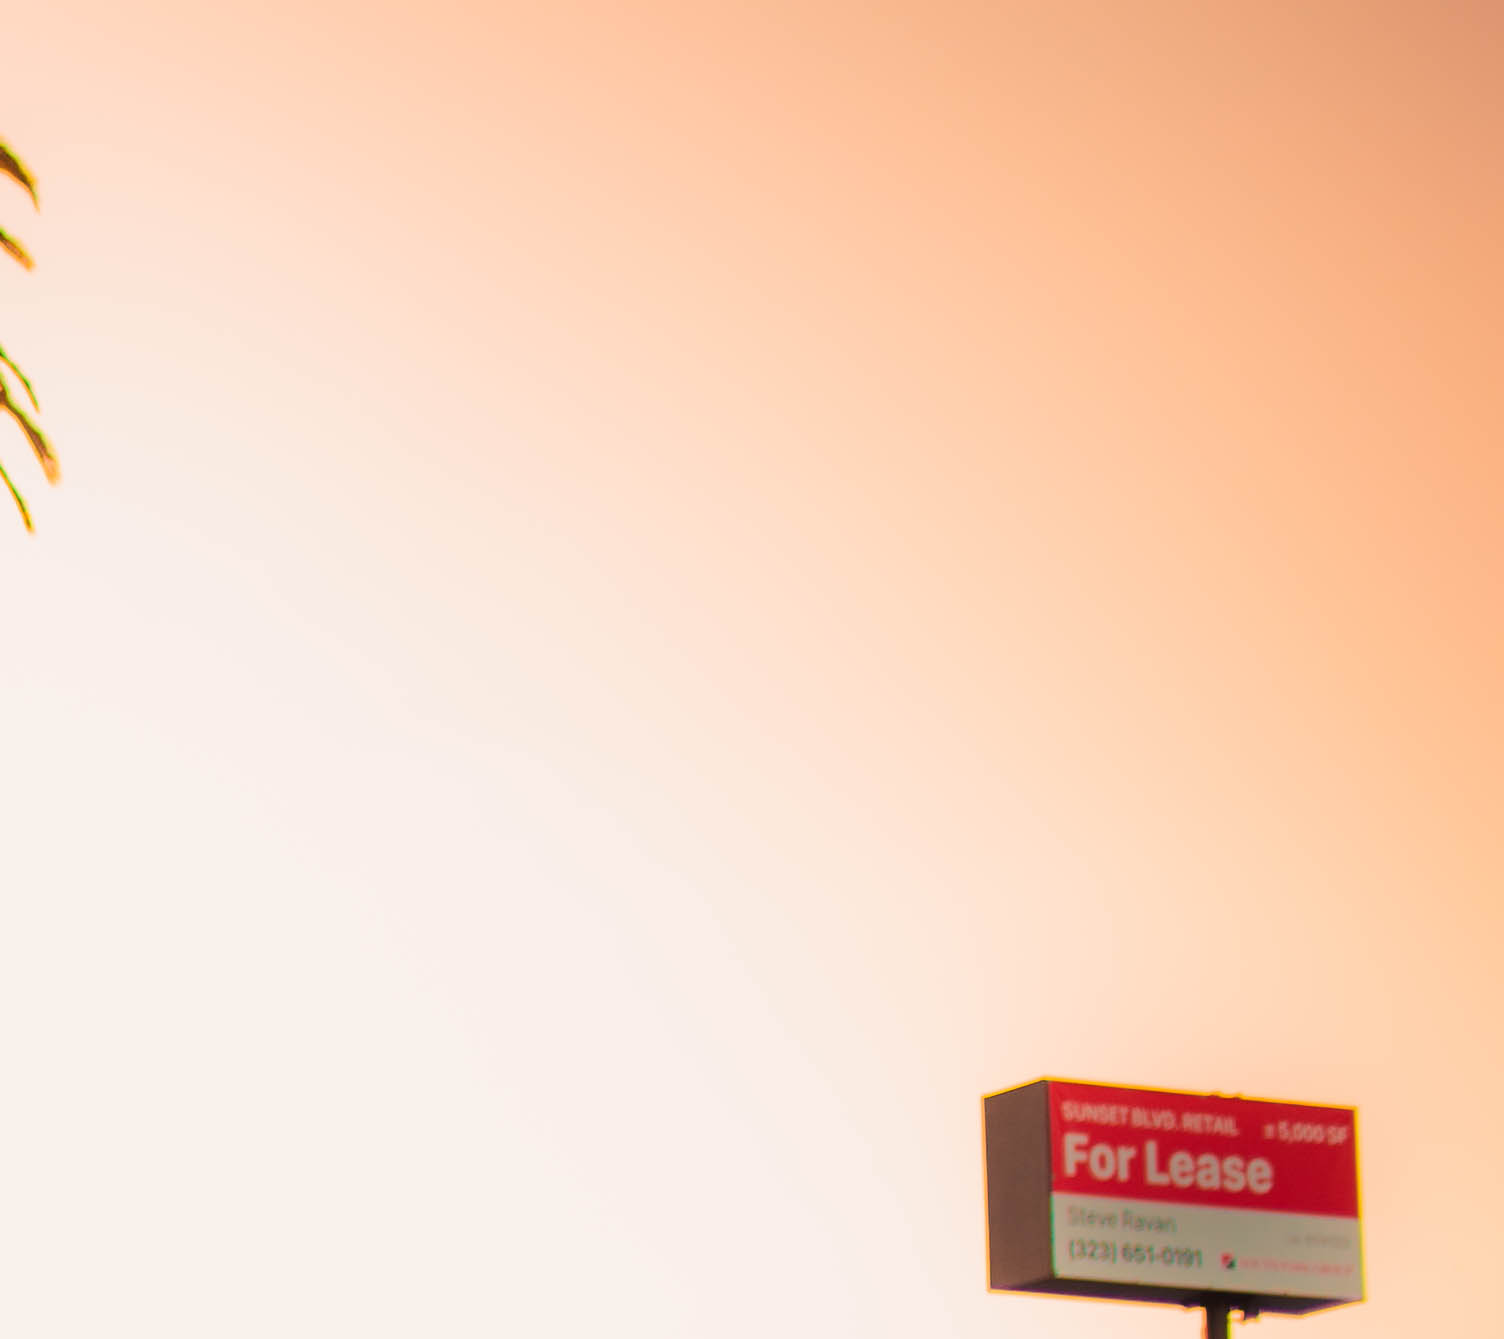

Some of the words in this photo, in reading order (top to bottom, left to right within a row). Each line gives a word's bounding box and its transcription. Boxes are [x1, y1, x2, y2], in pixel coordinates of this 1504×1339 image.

[1062, 1101, 1128, 1125] SUNSET
[1183, 1112, 1239, 1137] RETAIL
[1277, 1121, 1325, 1144] 5,000
[1327, 1125, 1348, 1146] SF
[1064, 1132, 1136, 1182] For
[1145, 1140, 1274, 1195] Lease
[1066, 1205, 1117, 1229] Steve
[1068, 1240, 1117, 1265] (323)
